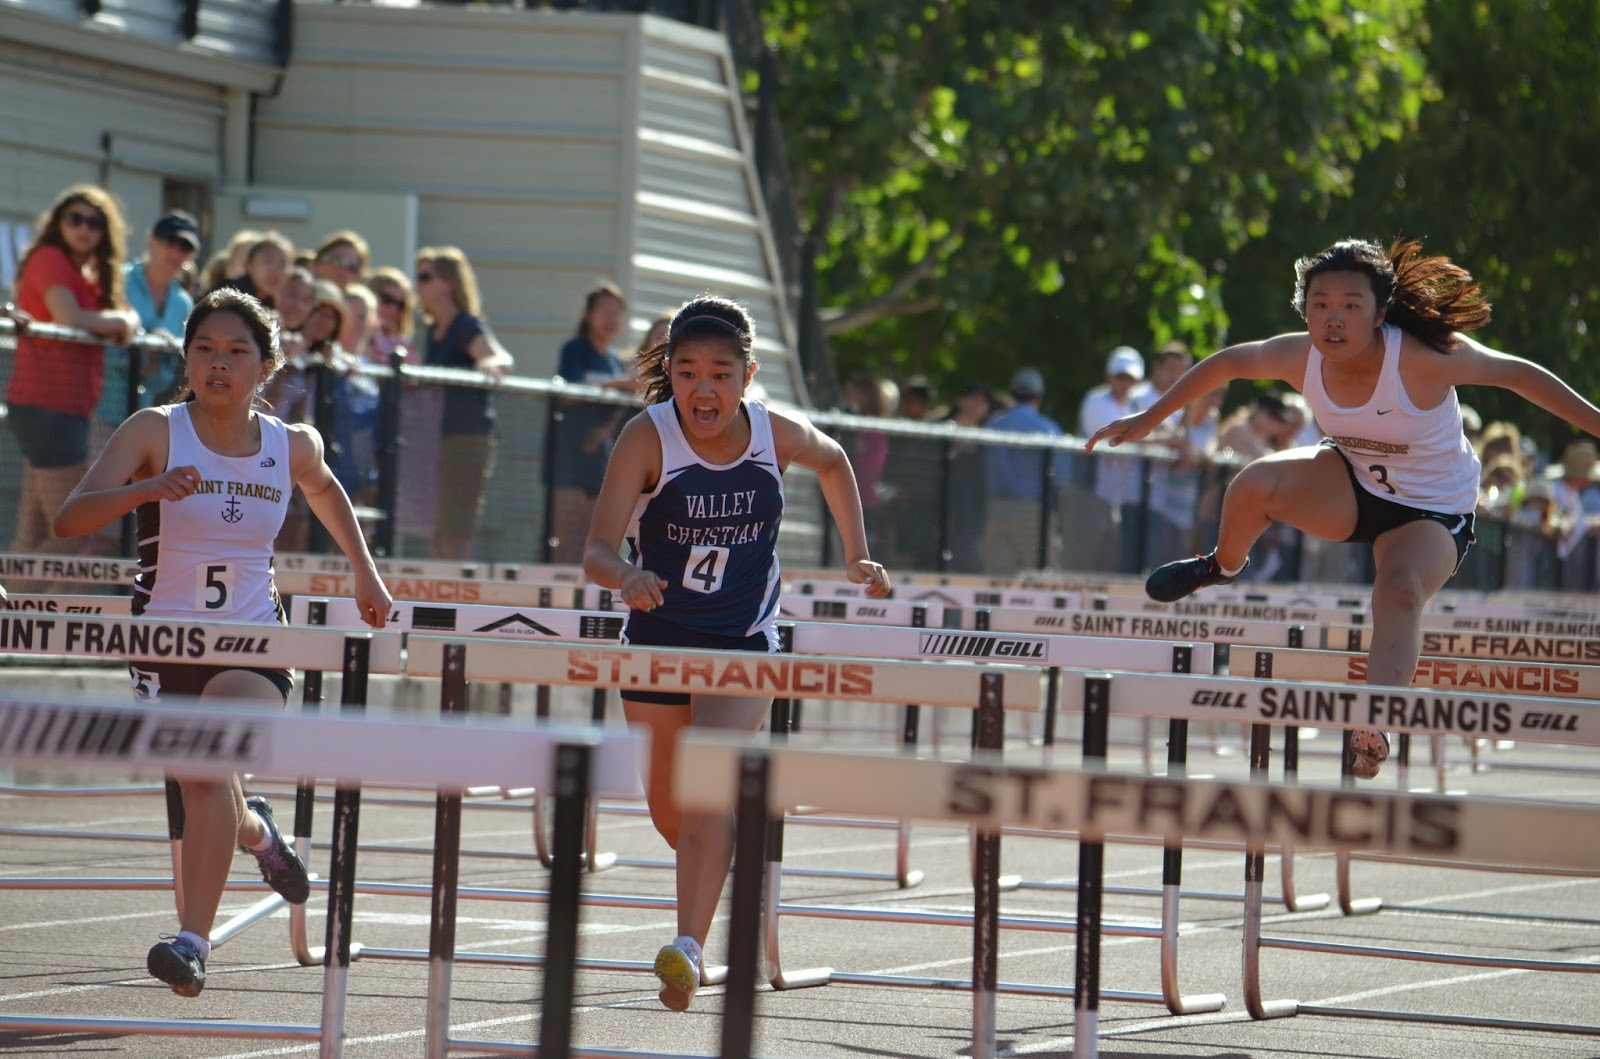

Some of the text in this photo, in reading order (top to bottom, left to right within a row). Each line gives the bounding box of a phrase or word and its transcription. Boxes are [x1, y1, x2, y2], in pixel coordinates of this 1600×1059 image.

[192, 480, 282, 503] AINT FRANCIS
[1368, 464, 1396, 495] 3
[686, 490, 757, 519] VALLEY
[667, 522, 765, 546] CHRISTIAN
[0, 559, 36, 577] INT
[43, 560, 120, 580] FRANCIS
[691, 549, 719, 591] 4
[205, 565, 228, 610] 5
[385, 578, 482, 601] ANCIS
[5, 599, 58, 613] NCIS
[856, 606, 887, 618] GILL
[1173, 602, 1216, 617] SAINT
[1222, 604, 1287, 621] FRANCIS
[1034, 614, 1247, 639] GILL SAINT FRANCIS GILL
[1485, 617, 1531, 634] SAINT
[0, 618, 270, 658] INT FRANCIS GILL
[995, 640, 1045, 658] GILL
[1191, 686, 1580, 735] GILL SAINT FRANCIS GILL
[148, 719, 256, 760] GILL
